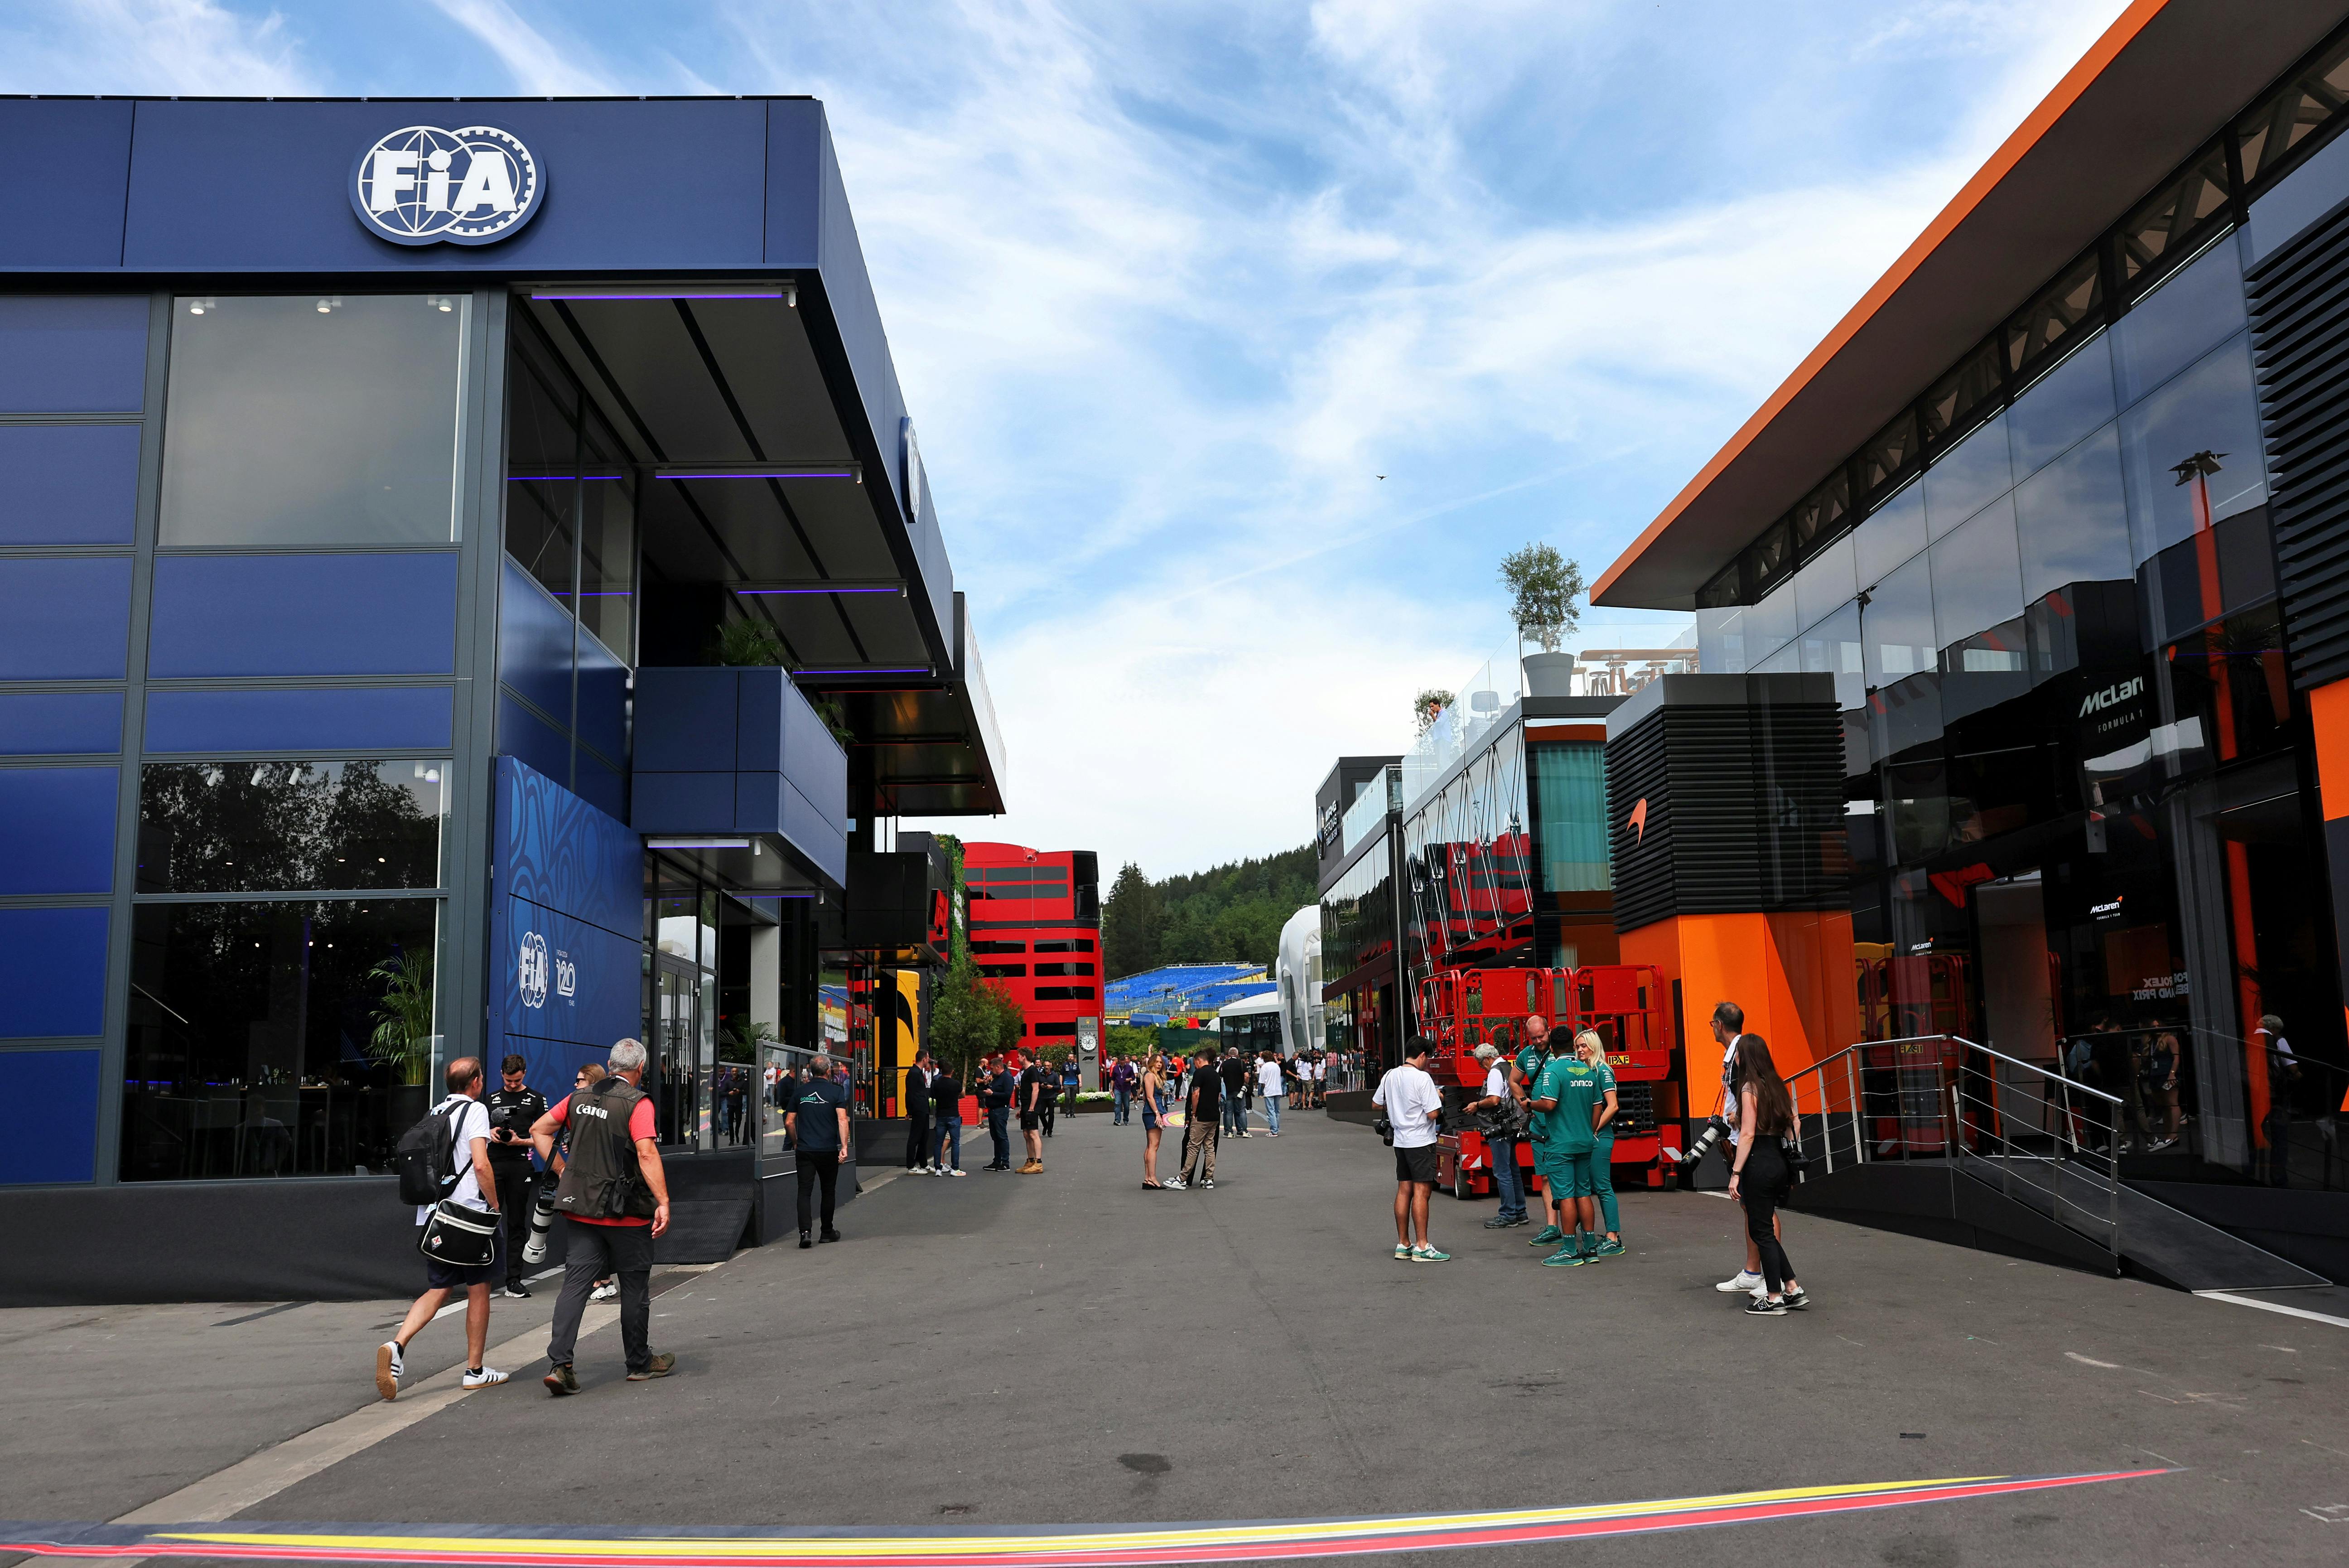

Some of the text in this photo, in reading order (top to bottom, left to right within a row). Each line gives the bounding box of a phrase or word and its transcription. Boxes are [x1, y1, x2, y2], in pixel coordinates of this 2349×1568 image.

[2098, 709, 2142, 733] FORMULA 1
[2090, 902, 2120, 914] McLaren
[1911, 942, 1931, 951] McLaren
[556, 958, 575, 997] 120
[1609, 1055, 1629, 1064] IPAF
